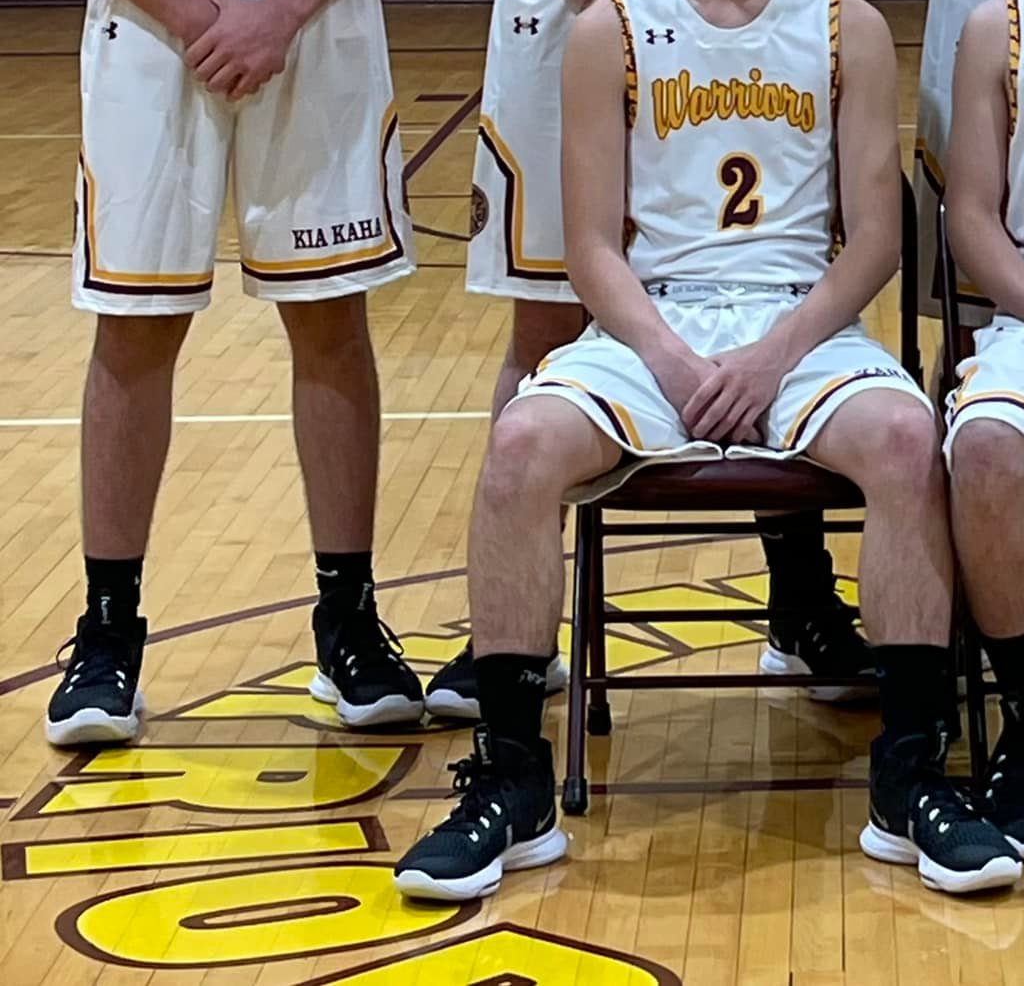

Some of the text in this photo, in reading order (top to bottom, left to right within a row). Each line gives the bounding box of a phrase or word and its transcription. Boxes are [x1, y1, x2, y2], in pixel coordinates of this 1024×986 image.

[652, 68, 816, 140] Warriors
[716, 151, 764, 231] 2
[292, 217, 383, 249] KIA KAHA
